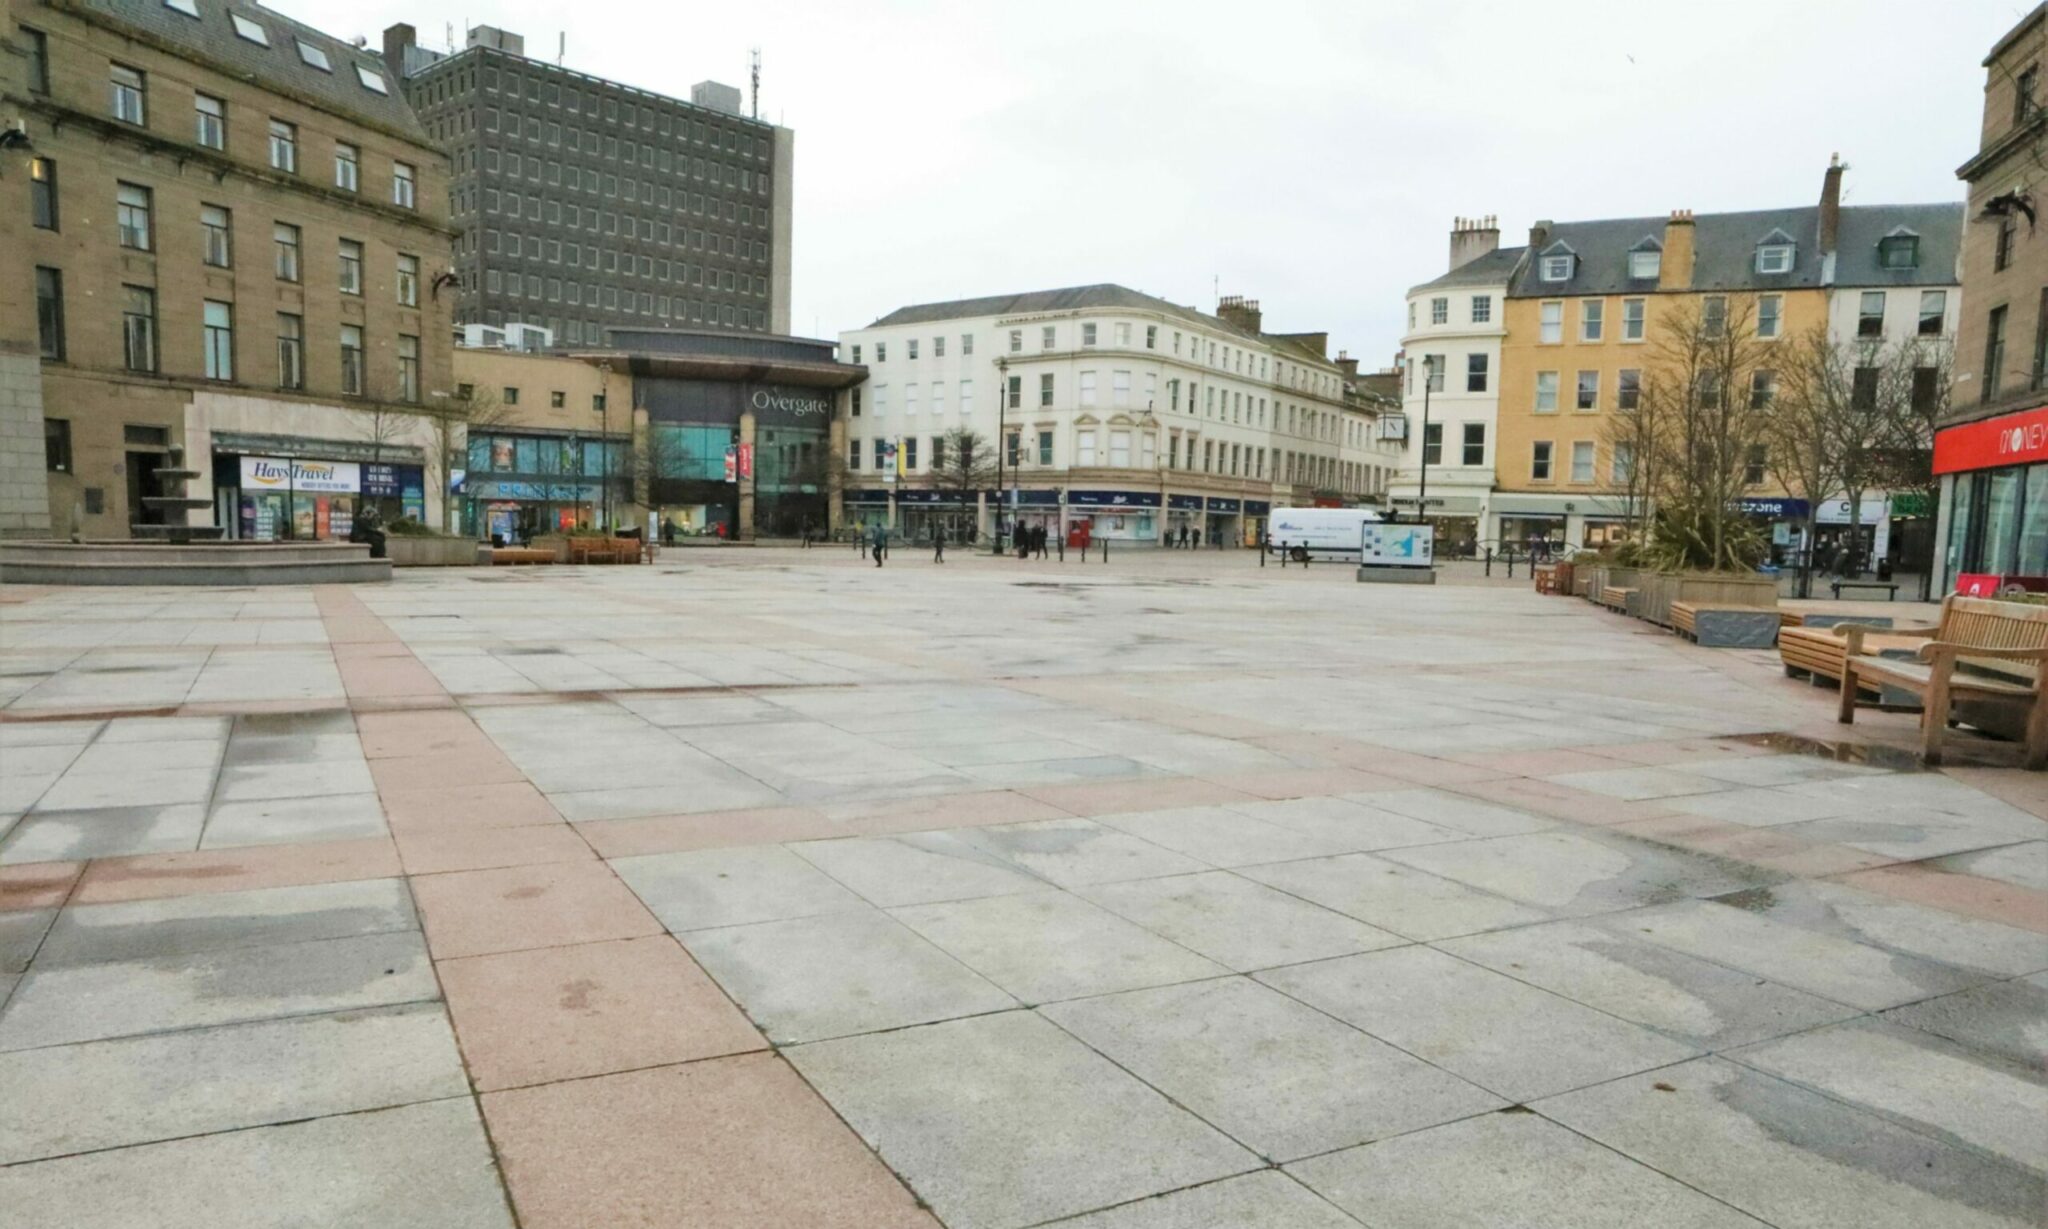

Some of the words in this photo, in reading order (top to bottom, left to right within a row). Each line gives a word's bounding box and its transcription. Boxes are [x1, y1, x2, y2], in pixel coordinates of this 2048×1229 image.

[752, 390, 828, 417] Overgate
[254, 461, 290, 480] Hays
[292, 463, 335, 481] Travel
